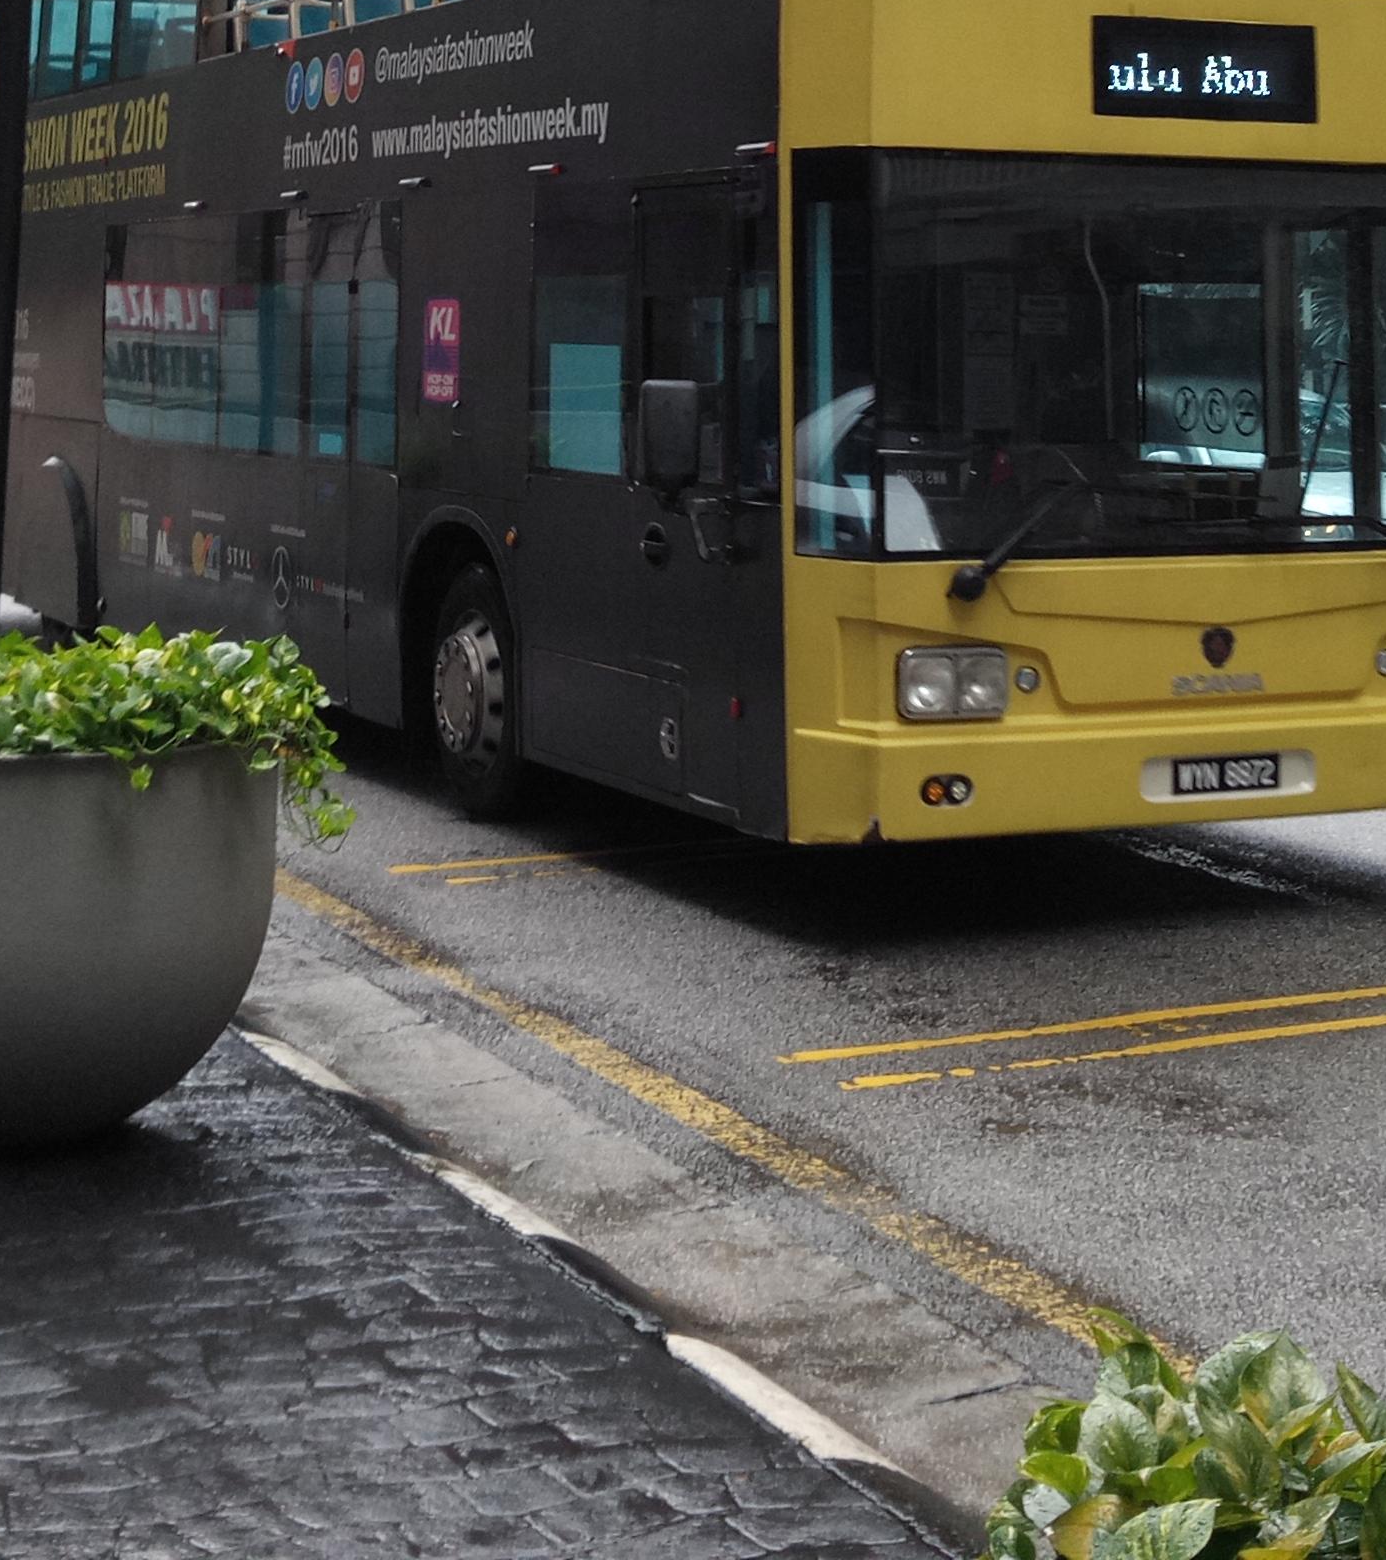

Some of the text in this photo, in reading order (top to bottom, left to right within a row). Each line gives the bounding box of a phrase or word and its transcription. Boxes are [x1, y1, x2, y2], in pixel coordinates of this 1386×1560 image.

[374, 19, 535, 85] @malaysiafashionweek
[23, 113, 68, 173] SHION
[71, 102, 121, 165] WEEK
[122, 91, 170, 155] 2016
[282, 96, 610, 171] #mfw2016 www.malaysiafashionweek.my
[52, 175, 85, 209] FASHION
[86, 170, 115, 204] TRADE
[116, 163, 166, 201] PLATFORM
[429, 306, 457, 342] KL
[1177, 761, 1221, 791] WYN
